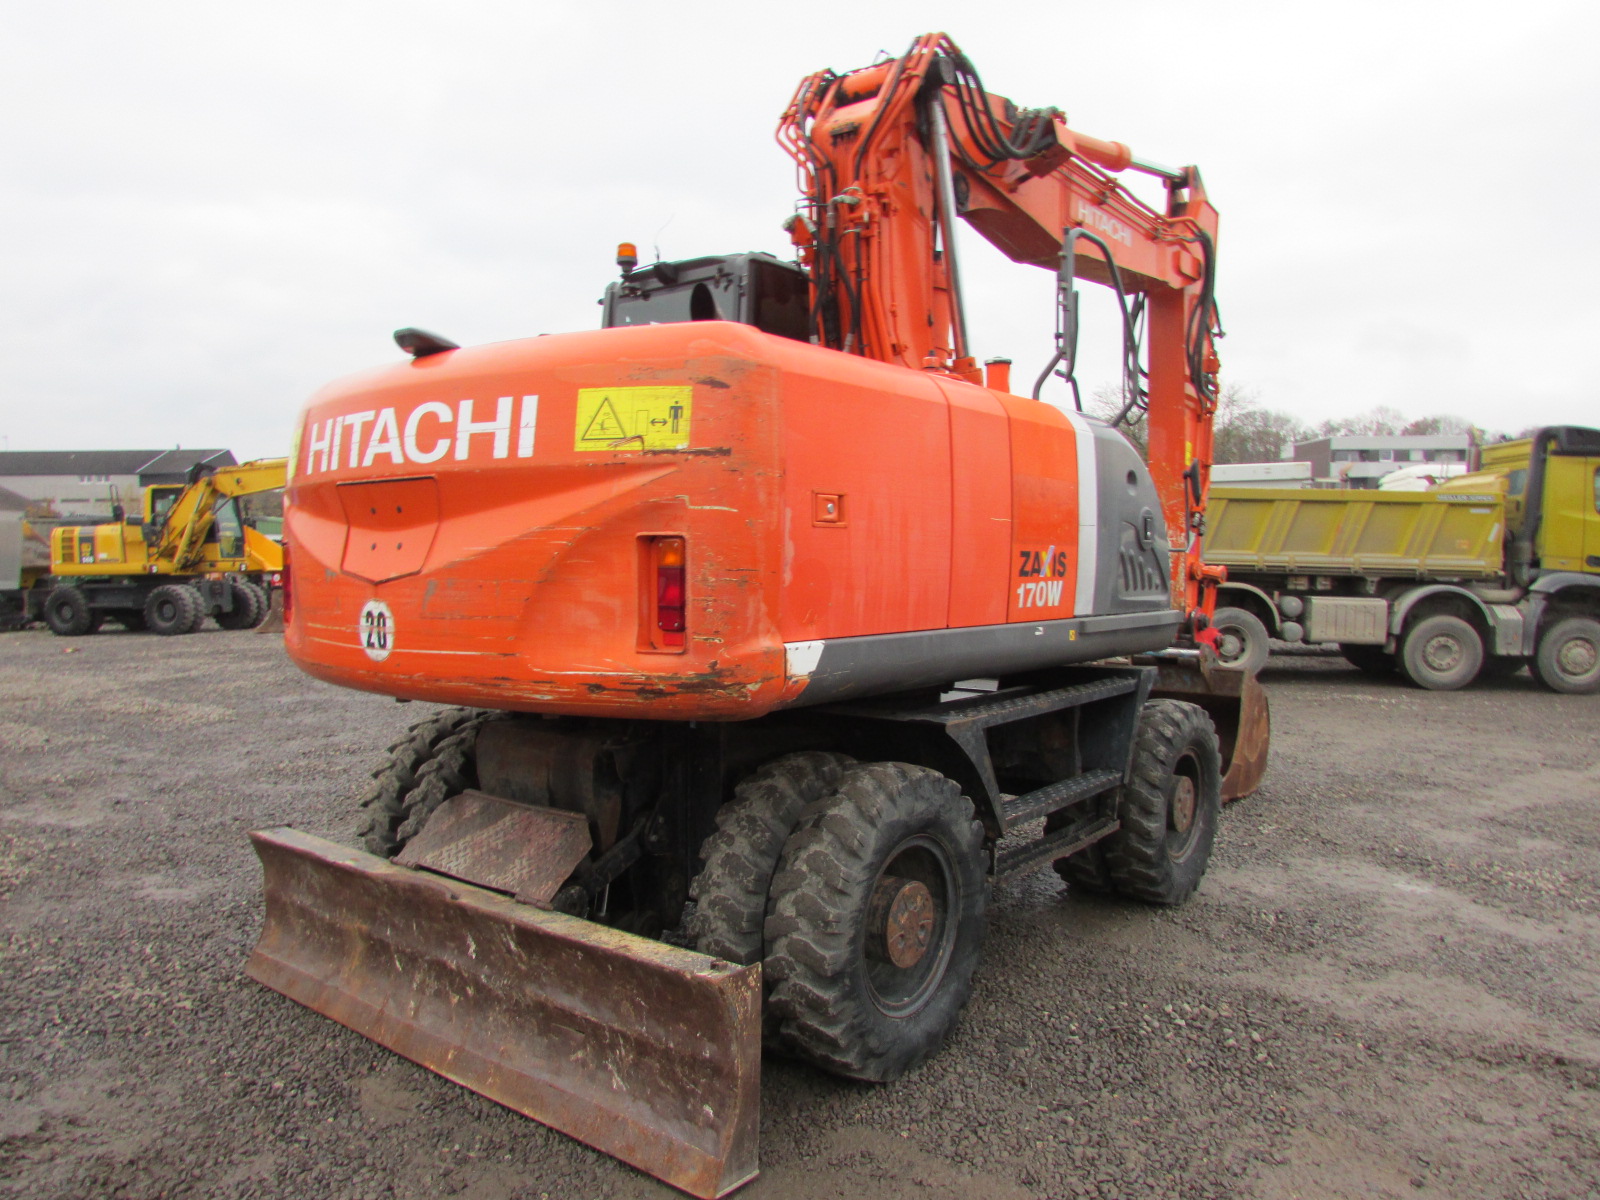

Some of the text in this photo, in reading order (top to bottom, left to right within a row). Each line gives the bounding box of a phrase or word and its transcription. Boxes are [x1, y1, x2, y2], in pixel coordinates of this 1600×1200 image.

[1078, 200, 1133, 247] HITACHI
[306, 394, 539, 475] HITACHI
[1019, 545, 1067, 577] ZAXIS
[1017, 580, 1064, 608] 170W
[365, 610, 387, 649] 20
